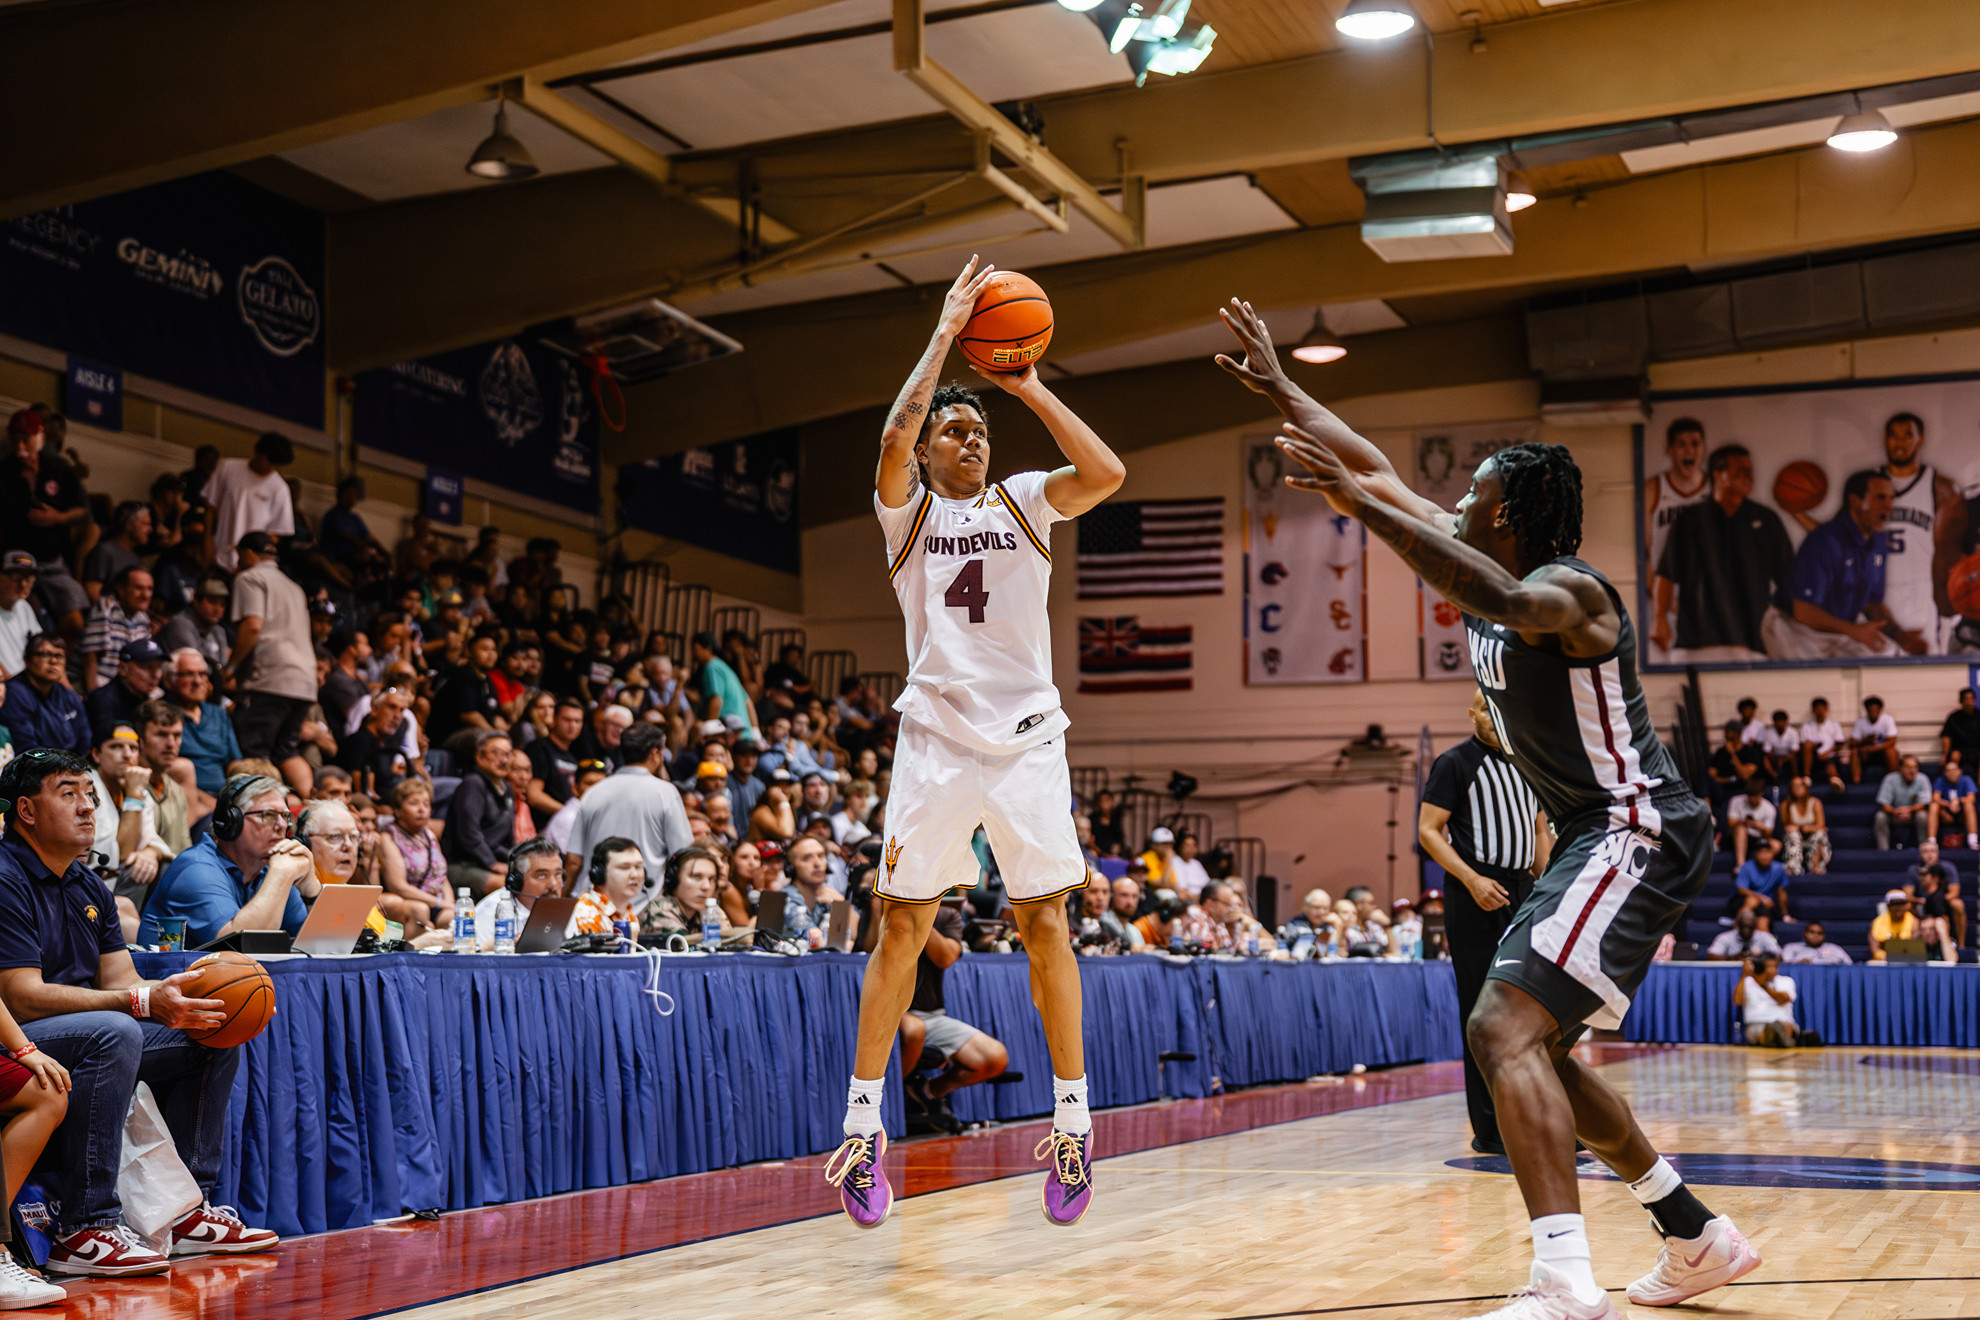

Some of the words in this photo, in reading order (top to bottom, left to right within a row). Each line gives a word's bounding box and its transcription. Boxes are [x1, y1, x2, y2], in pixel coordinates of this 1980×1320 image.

[957, 531, 1017, 556] DEVILS
[944, 559, 989, 624] 4
[22, 1209, 48, 1220] MAUI
